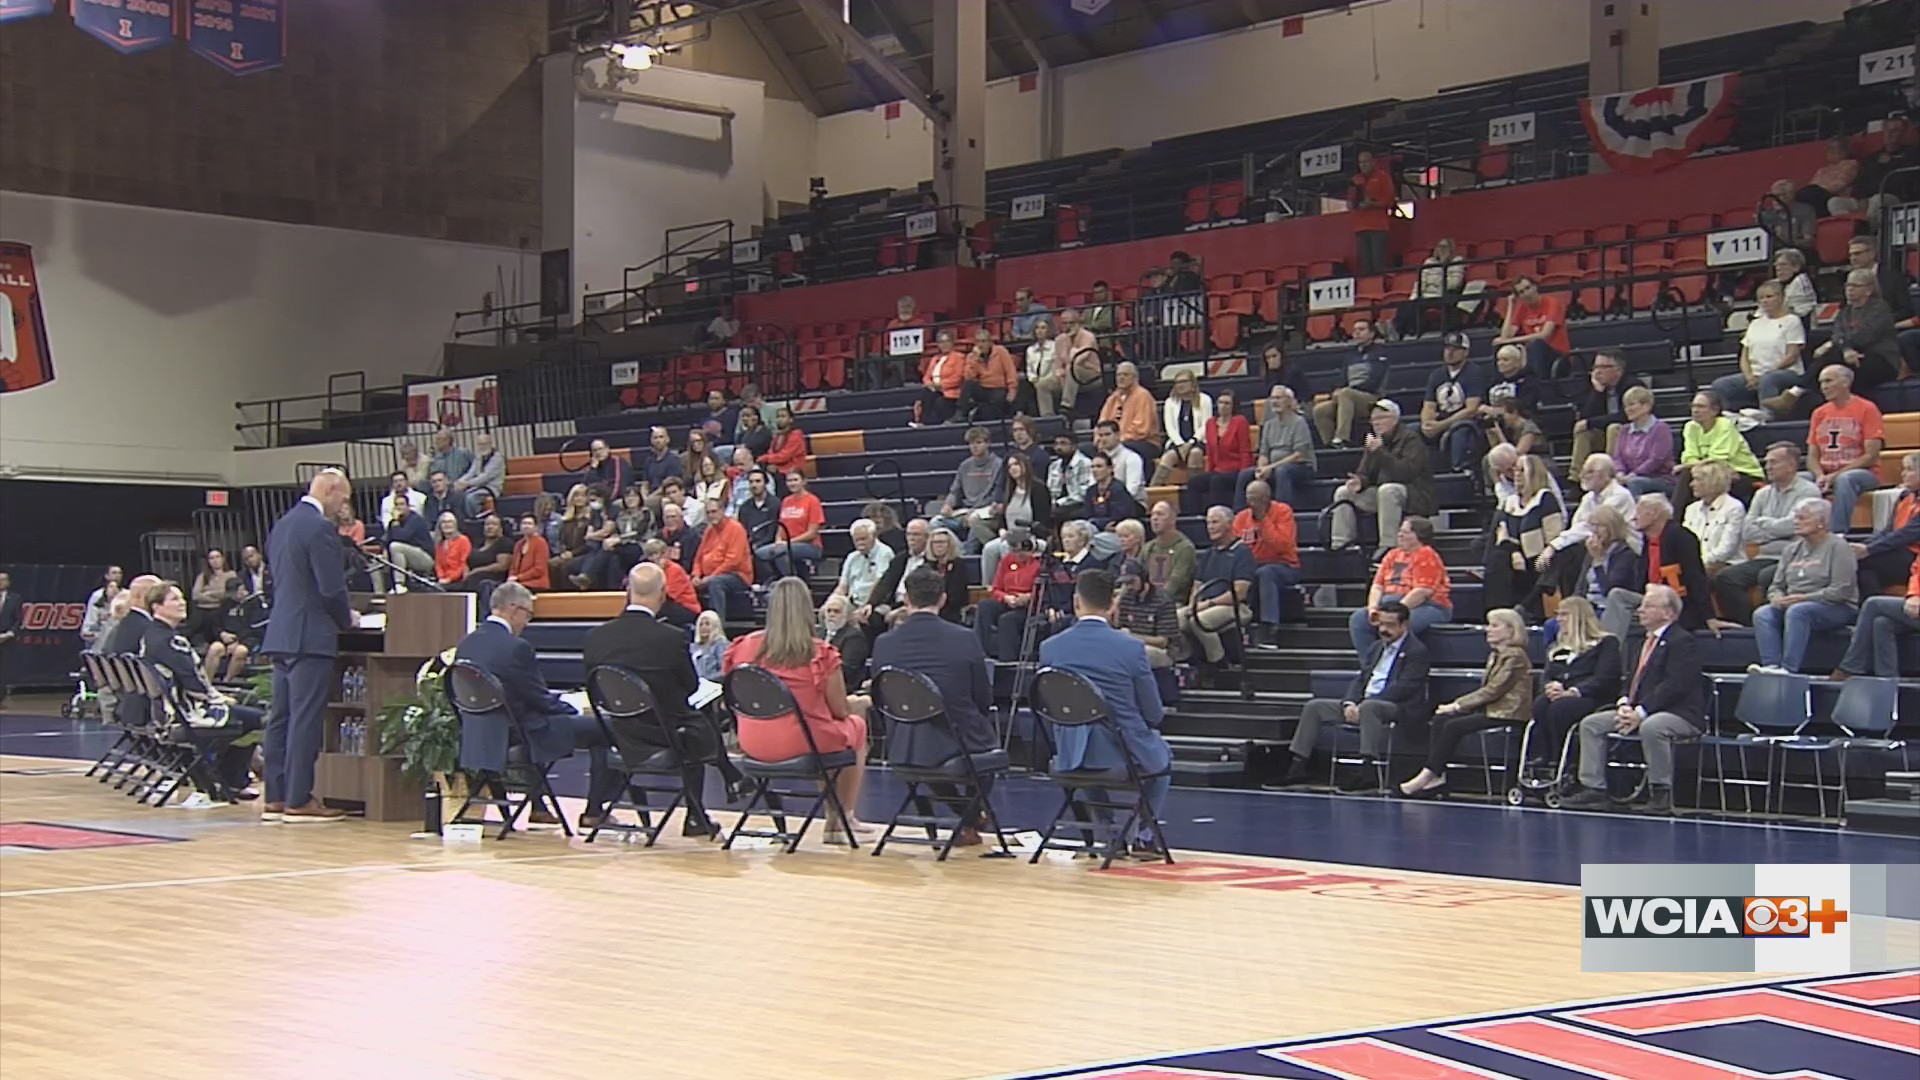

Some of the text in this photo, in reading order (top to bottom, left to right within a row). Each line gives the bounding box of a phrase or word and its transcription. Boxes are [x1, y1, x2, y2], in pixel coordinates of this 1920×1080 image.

[1491, 122, 1516, 137] 211
[1315, 152, 1338, 166] 210
[1023, 199, 1041, 213] 210
[1731, 236, 1762, 253] 111
[1326, 285, 1350, 300] 111
[893, 335, 910, 348] 110
